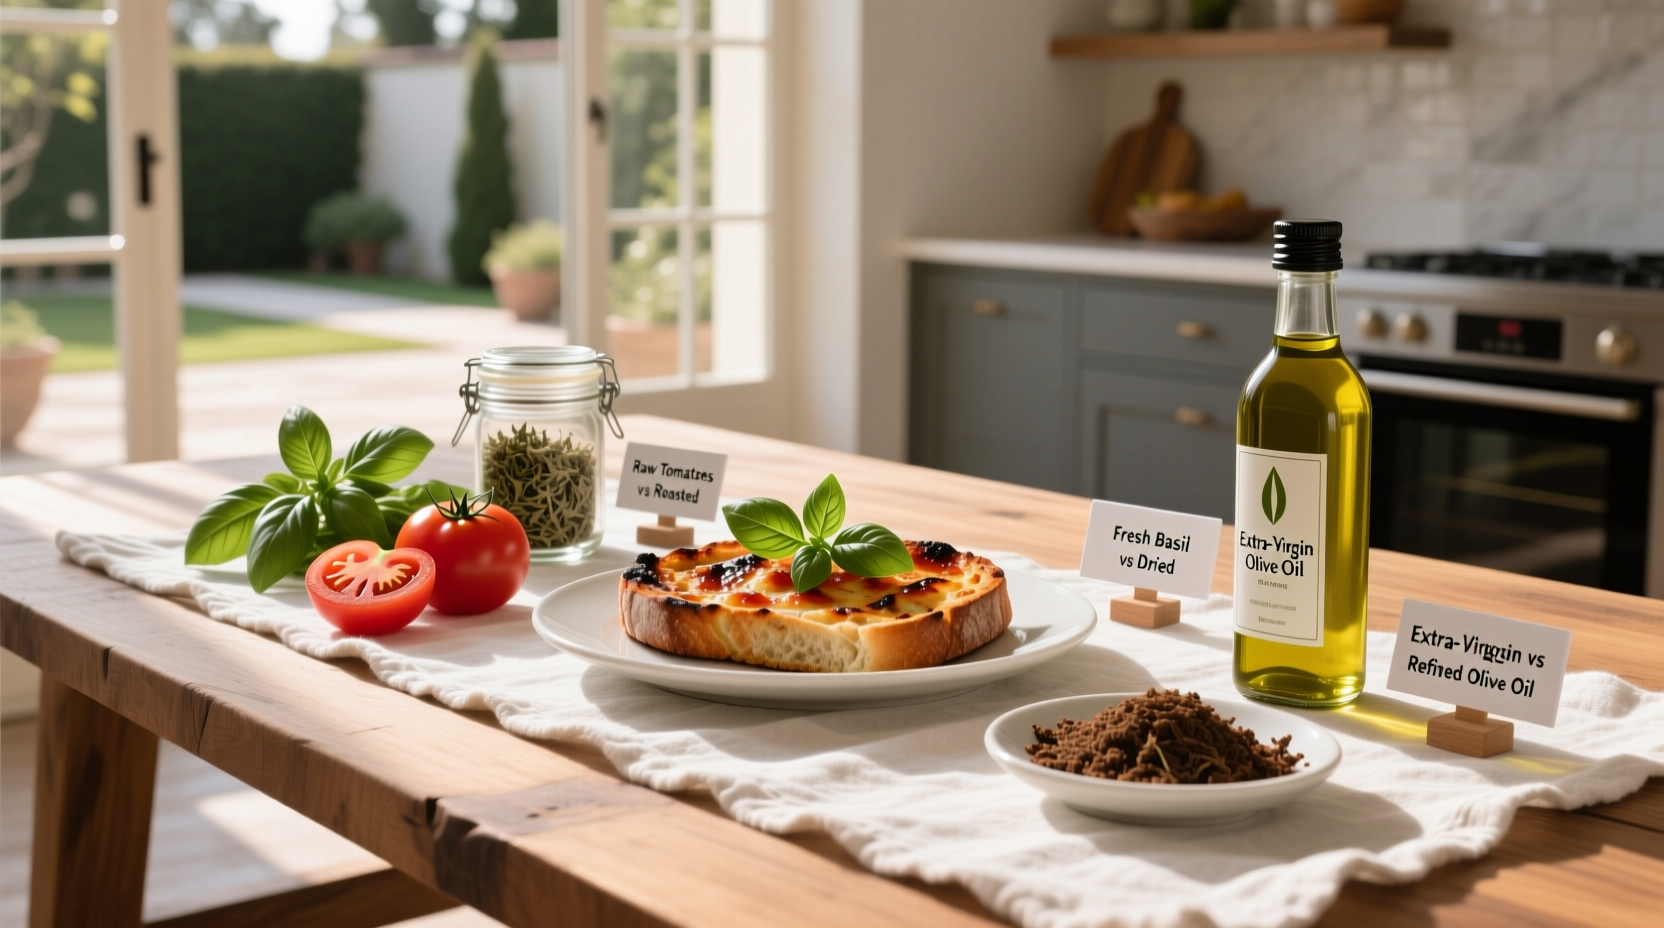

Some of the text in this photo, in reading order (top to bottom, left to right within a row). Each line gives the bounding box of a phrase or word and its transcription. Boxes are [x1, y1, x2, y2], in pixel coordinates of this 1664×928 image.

[632, 459, 658, 474] Raw
[638, 483, 700, 504] vs Roasted
[1113, 525, 1191, 553] Fresh Basil
[1119, 553, 1176, 575] vs Dried
[1245, 553, 1304, 577] Olive Oil
[1528, 652, 1546, 668] vs
[1467, 667, 1507, 691] Olive
[1511, 677, 1535, 698] Oil
